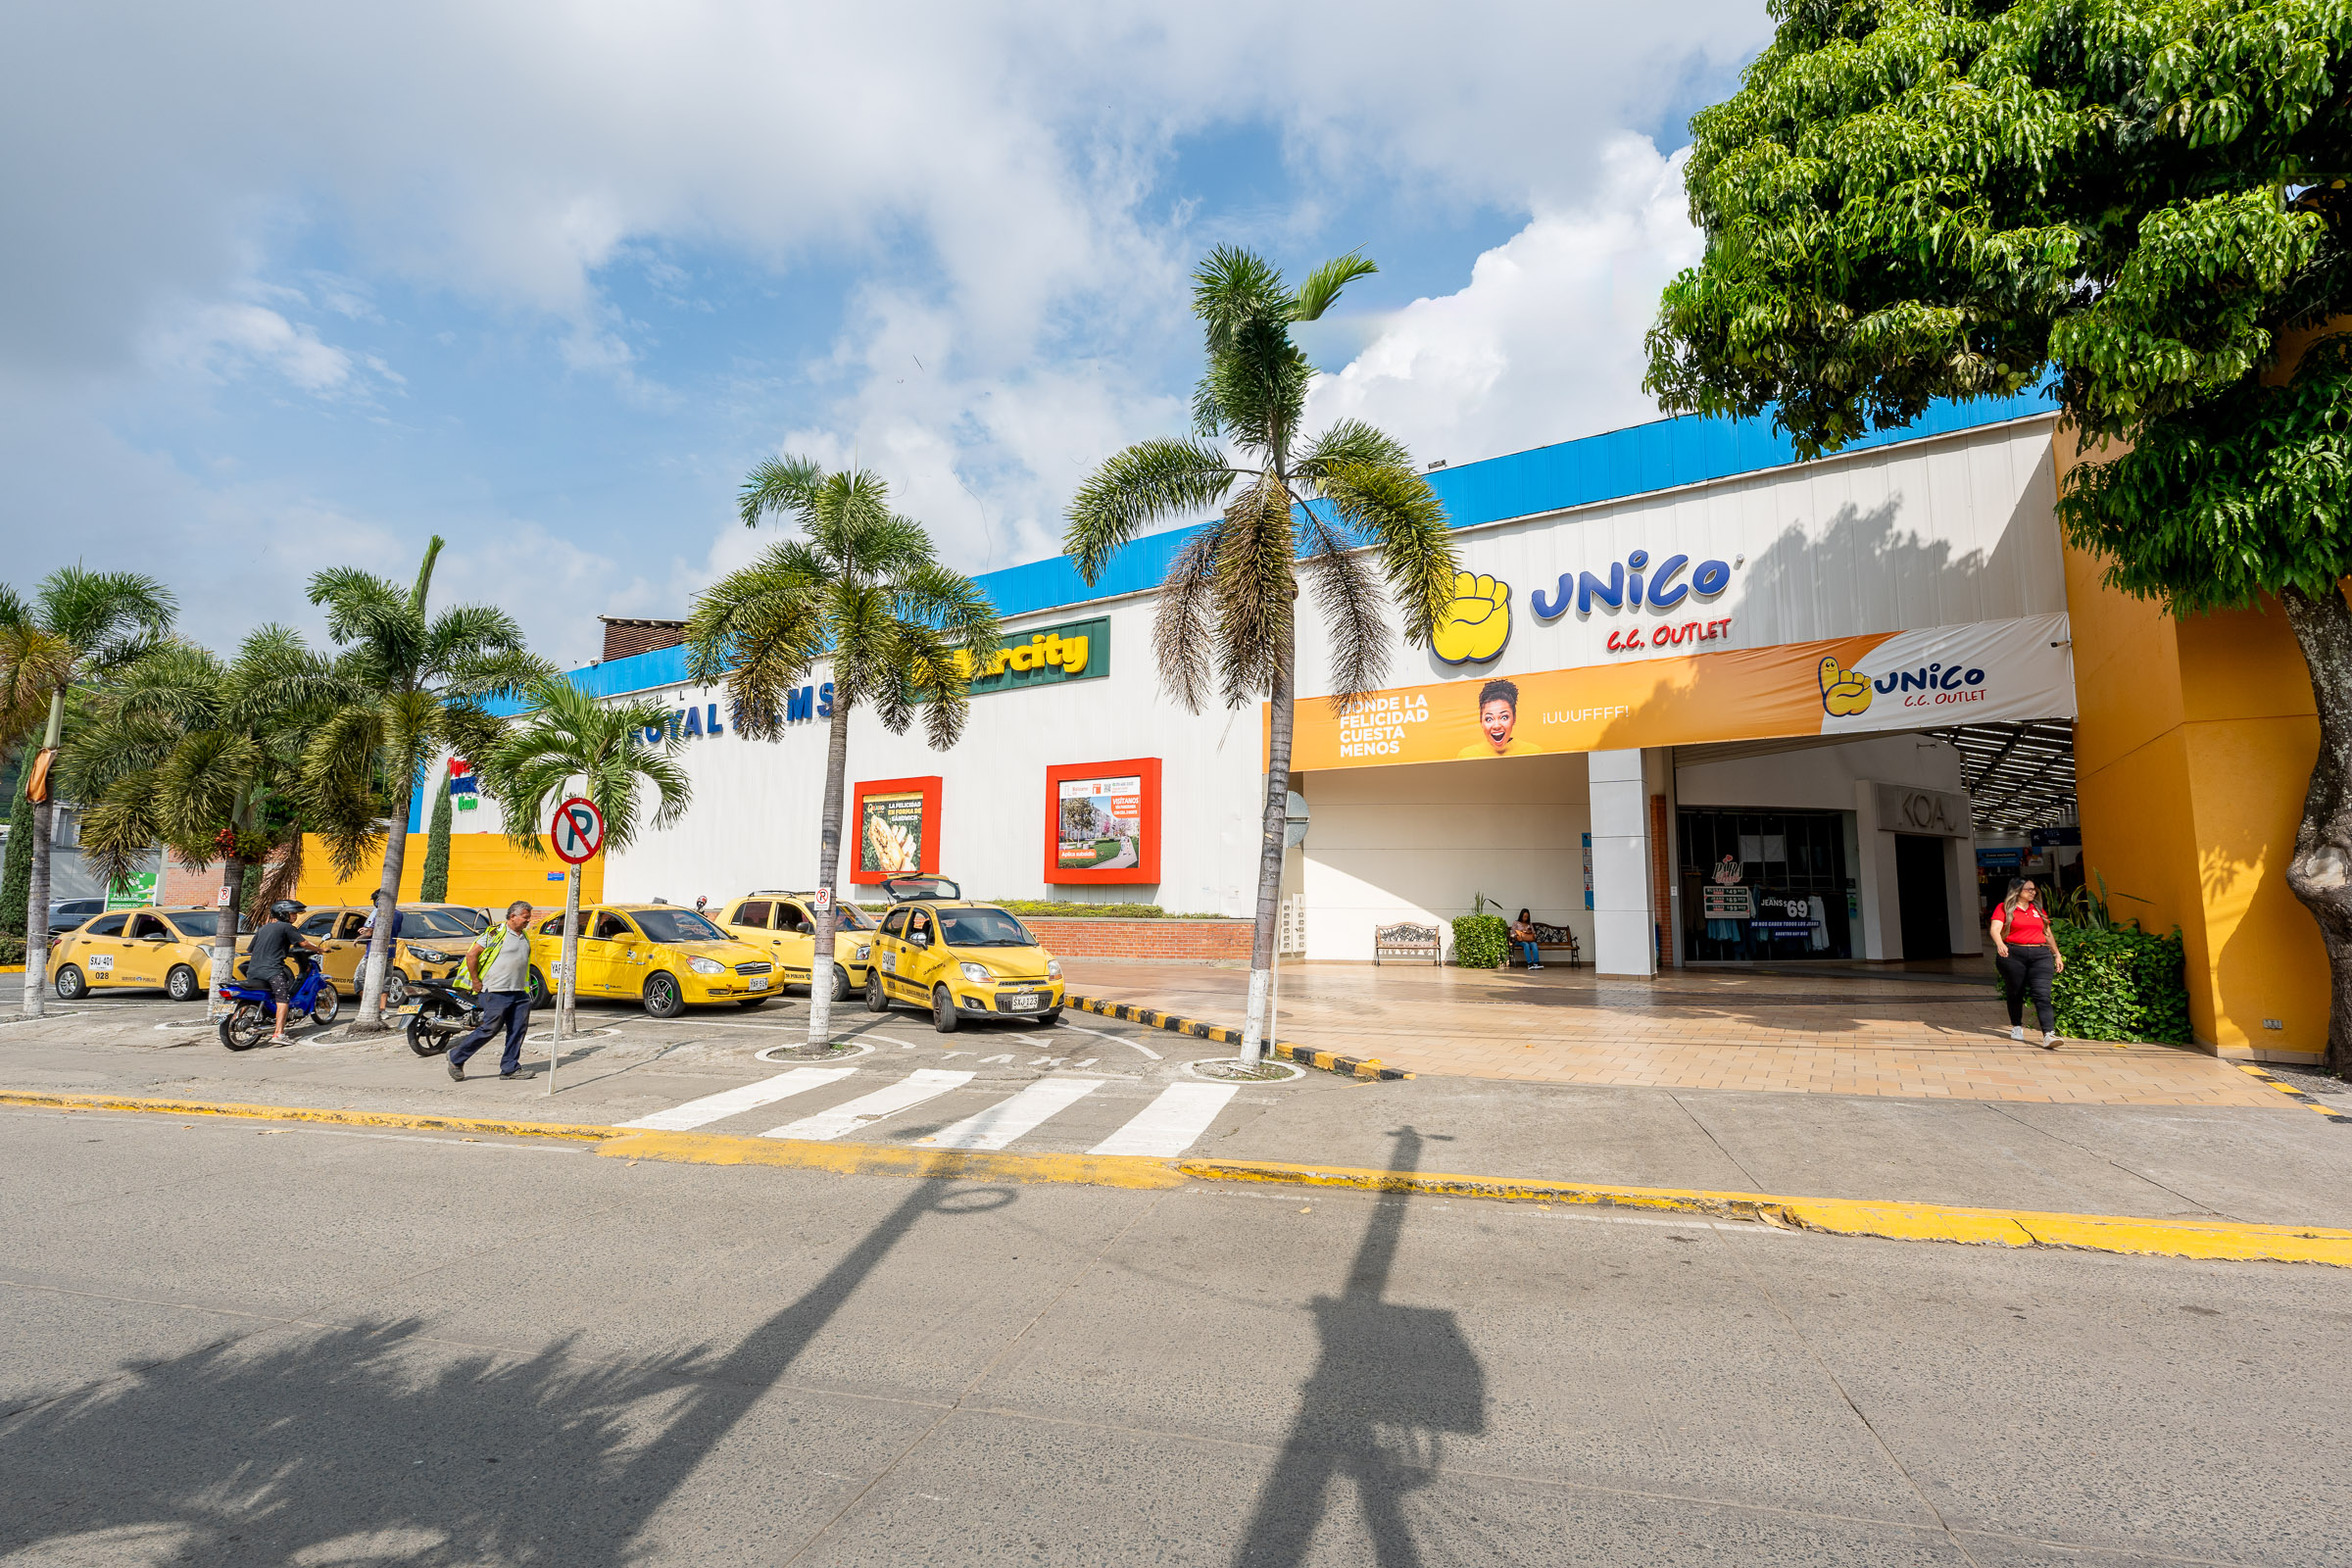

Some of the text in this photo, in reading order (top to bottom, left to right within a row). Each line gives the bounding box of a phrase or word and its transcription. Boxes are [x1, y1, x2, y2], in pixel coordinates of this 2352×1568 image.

[1606, 617, 1733, 651] C.C. OUTLET
[1404, 694, 1428, 709] LA
[1904, 689, 1987, 707] C.C. OUTLET
[1340, 709, 1429, 729] FELICIDAD
[1543, 705, 1629, 725] ¡UUUFFFF!
[1340, 725, 1405, 744] CUESTA
[1340, 740, 1400, 758] MENOS
[896, 801, 921, 809] FELICIDAD
[95, 971, 110, 980] 028
